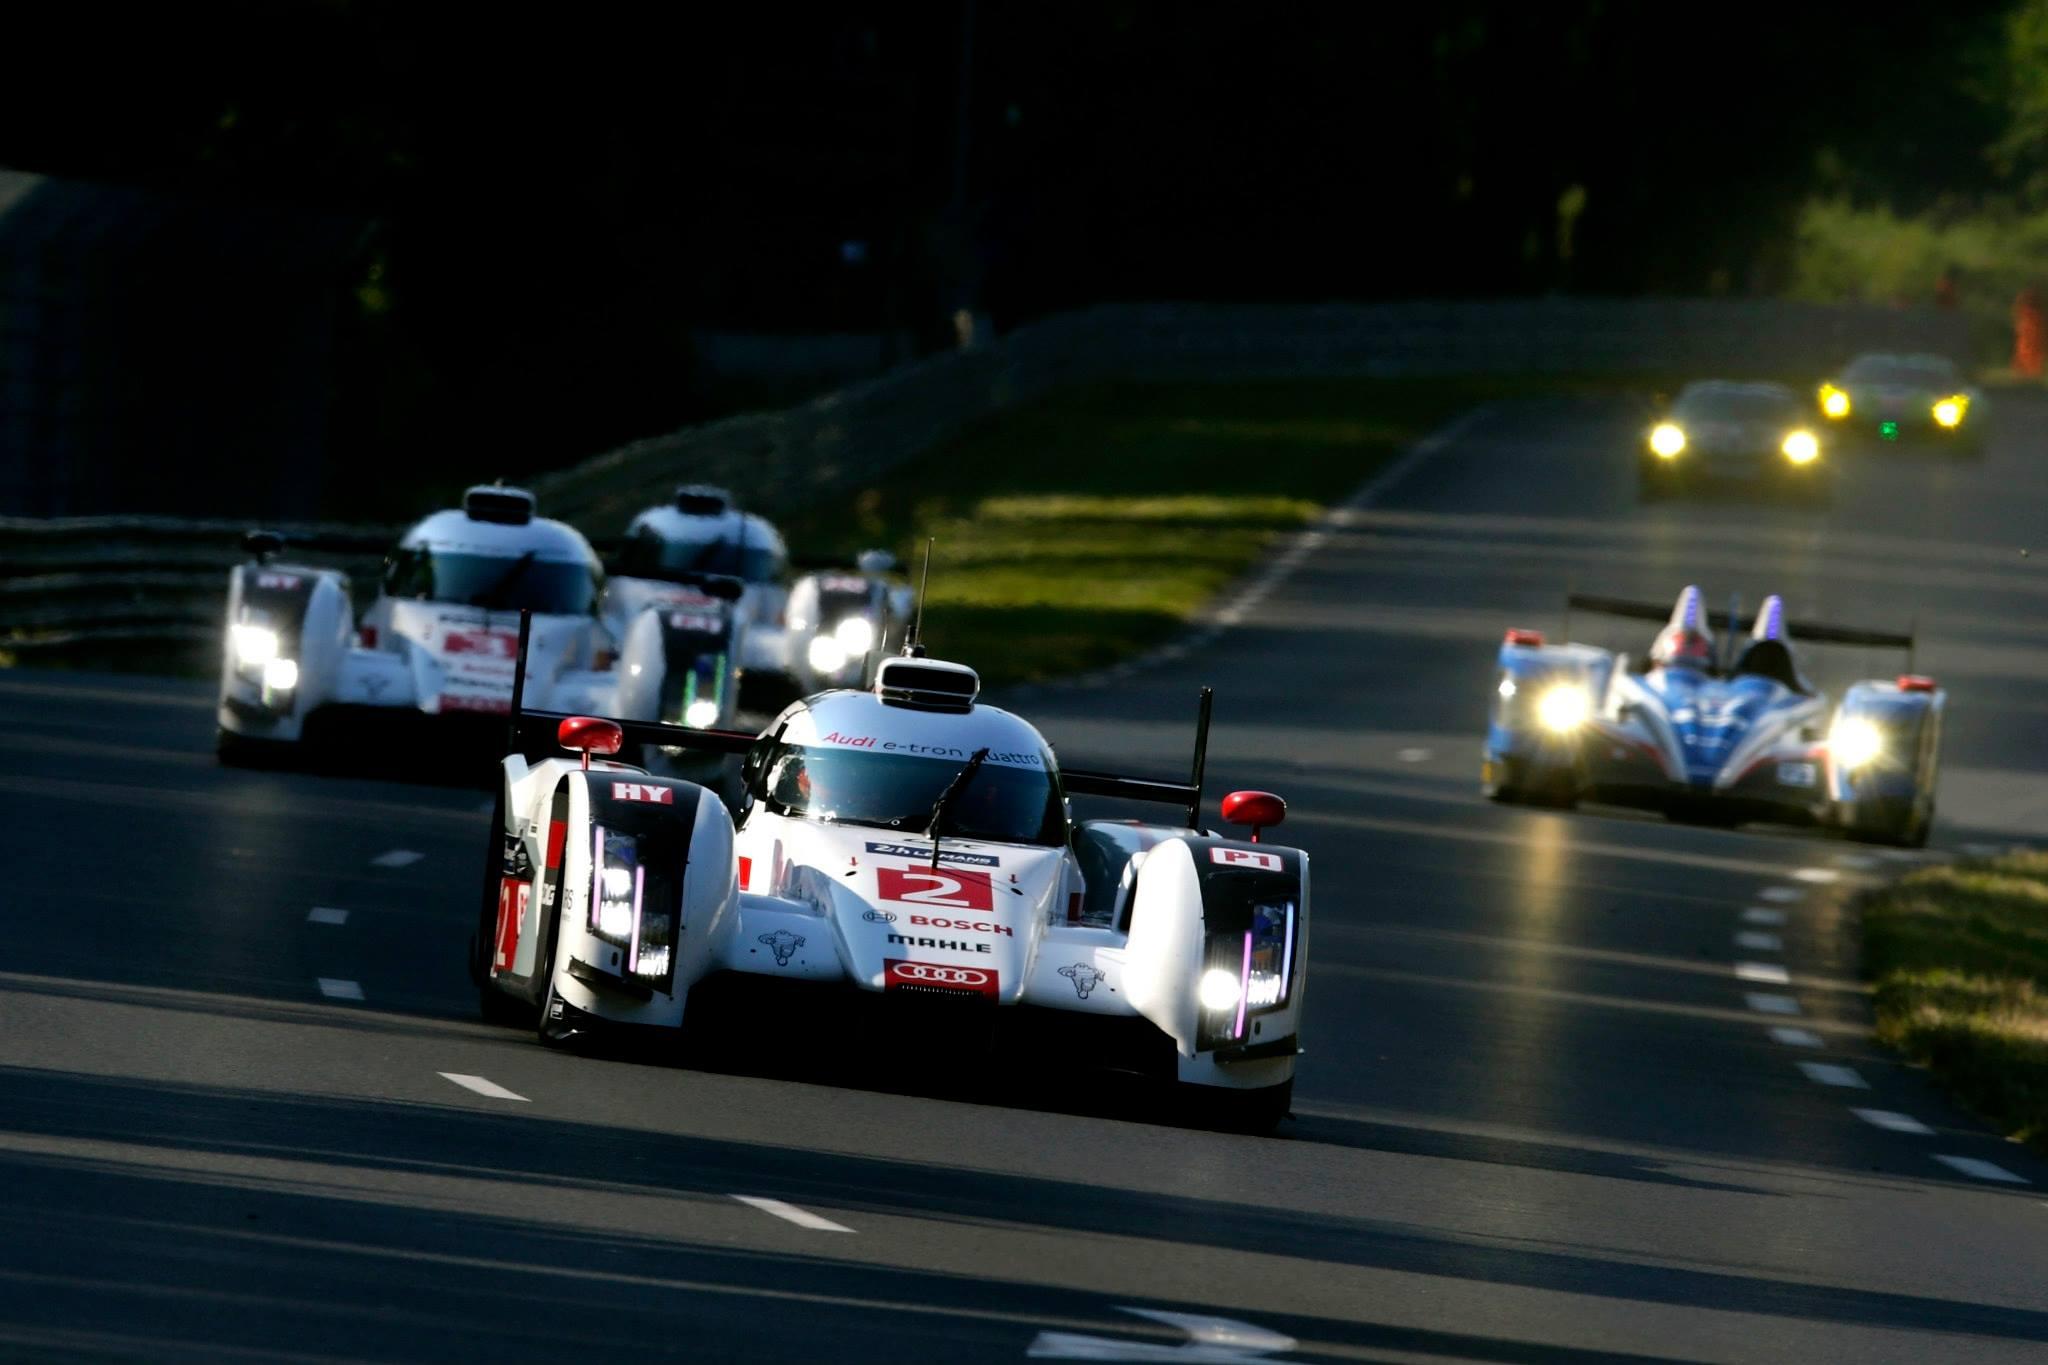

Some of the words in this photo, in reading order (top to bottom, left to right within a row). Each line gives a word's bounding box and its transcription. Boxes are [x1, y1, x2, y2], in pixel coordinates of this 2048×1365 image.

[824, 732, 877, 748] Audi
[883, 741, 963, 757] e-tron
[971, 751, 1039, 765] uattro
[615, 783, 672, 802] HY
[938, 853, 992, 865] MANS
[1224, 850, 1270, 867] P1
[900, 873, 970, 907] 2
[910, 915, 1014, 937] BOSCH
[887, 933, 992, 954] MAHLE
